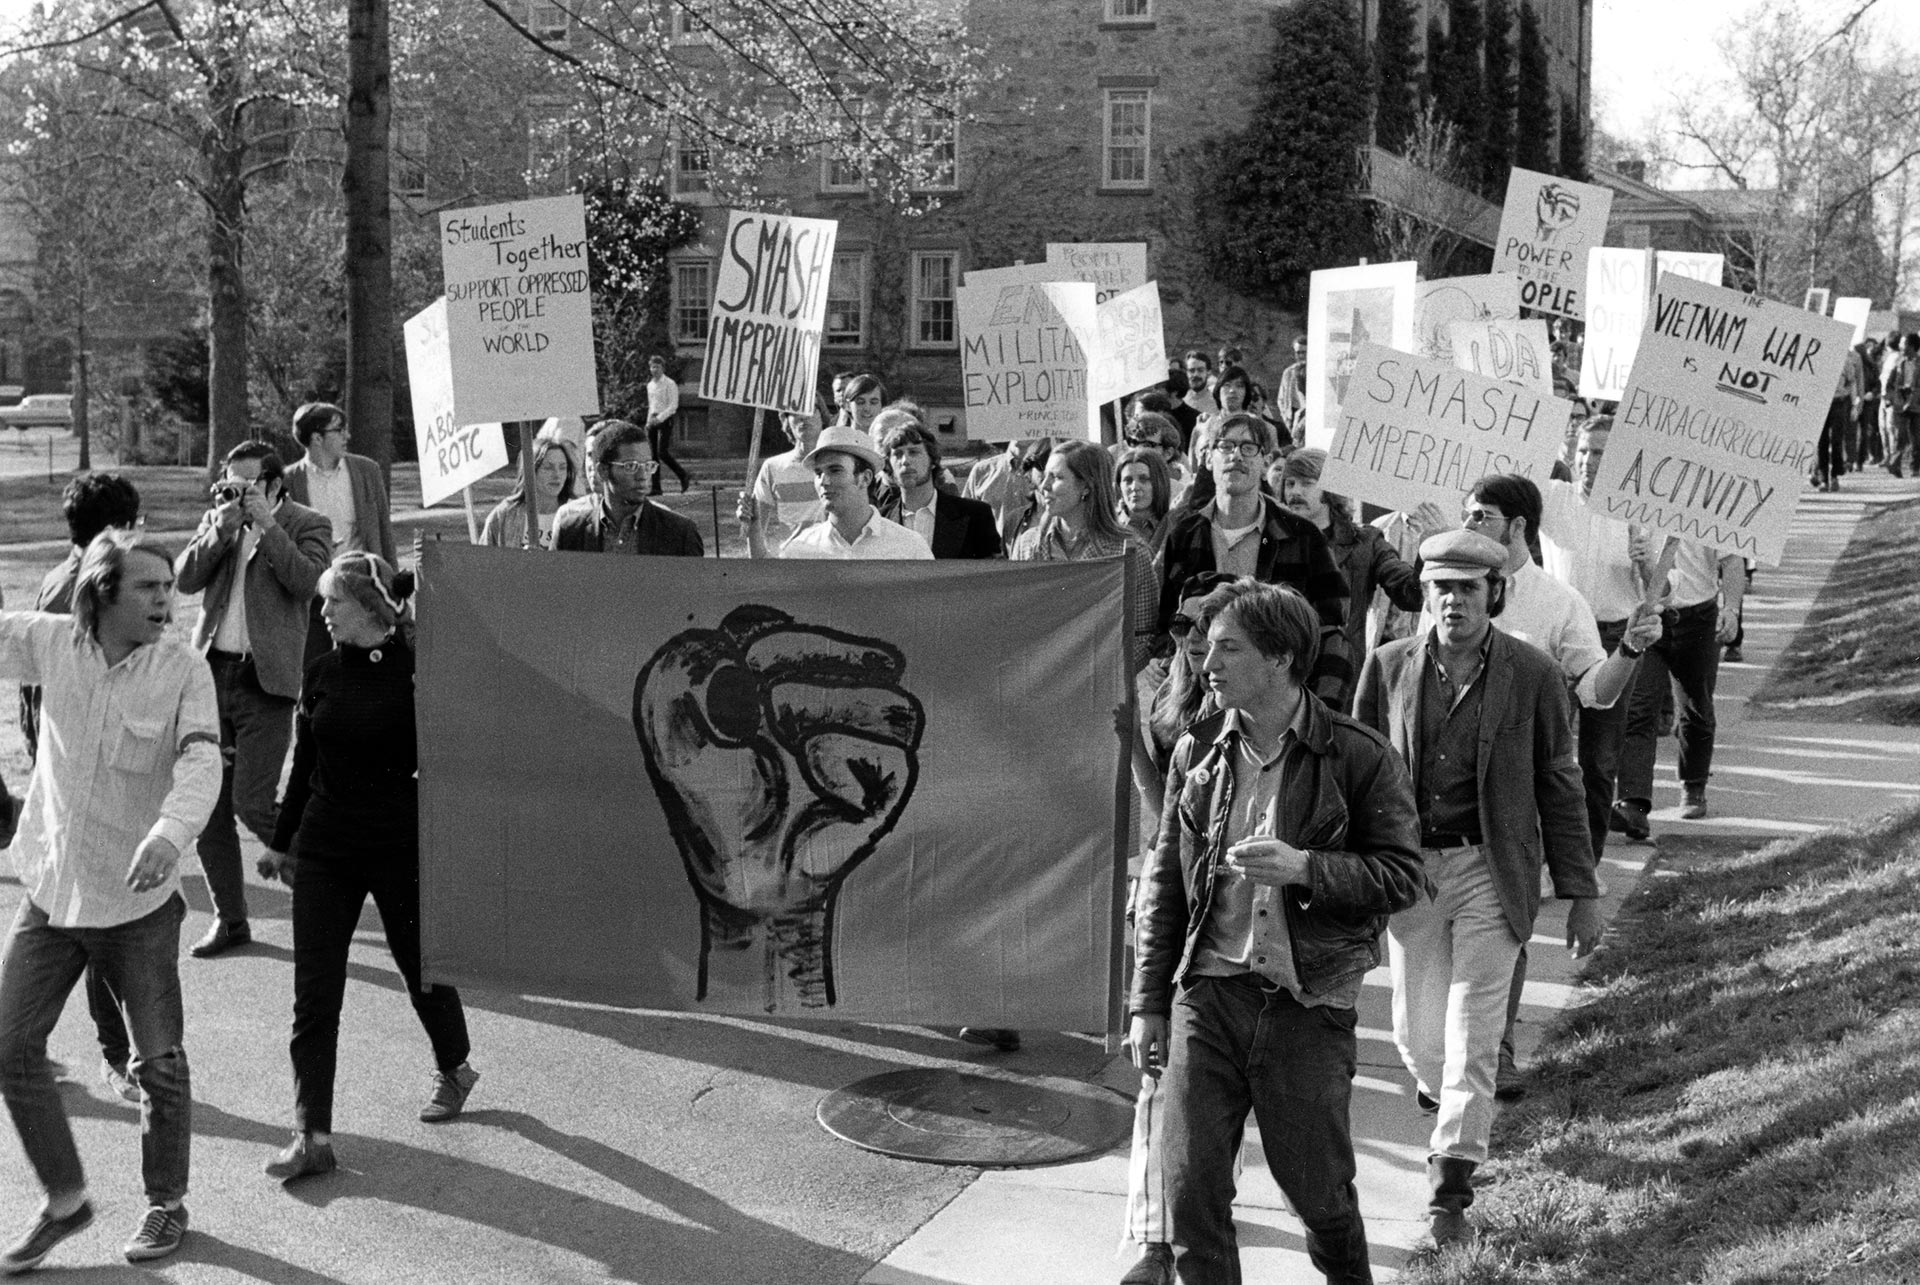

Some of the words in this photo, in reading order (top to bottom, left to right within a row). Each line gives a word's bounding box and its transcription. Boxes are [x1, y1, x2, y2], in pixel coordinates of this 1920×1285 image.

[446, 212, 526, 245] Students
[489, 234, 588, 272] Together
[718, 217, 830, 322] SMASH
[1505, 236, 1573, 270] POWER
[1518, 264, 1531, 277] TO
[1536, 268, 1561, 283] THE
[447, 276, 512, 302] SUPPORT
[518, 269, 589, 295] OPPRESSED
[1516, 275, 1579, 316] OPLE.
[1600, 256, 1638, 295] NO
[478, 296, 546, 322] PEOPLE
[1096, 289, 1120, 305] OT
[482, 332, 550, 355] WORLD
[1654, 294, 1748, 354] VIETNAM
[1762, 326, 1822, 376] WAR
[703, 316, 822, 414] IMPERIALISM
[1094, 338, 1160, 390] OTC
[1590, 347, 1630, 391] VIE
[1719, 362, 1781, 393] NOT
[1367, 360, 1541, 441] SMASH
[424, 411, 457, 455] ABO
[1624, 386, 1816, 476] EXTRACURRICULAR
[438, 427, 483, 478] ROTC
[1619, 449, 1774, 528] ACTIVITY
